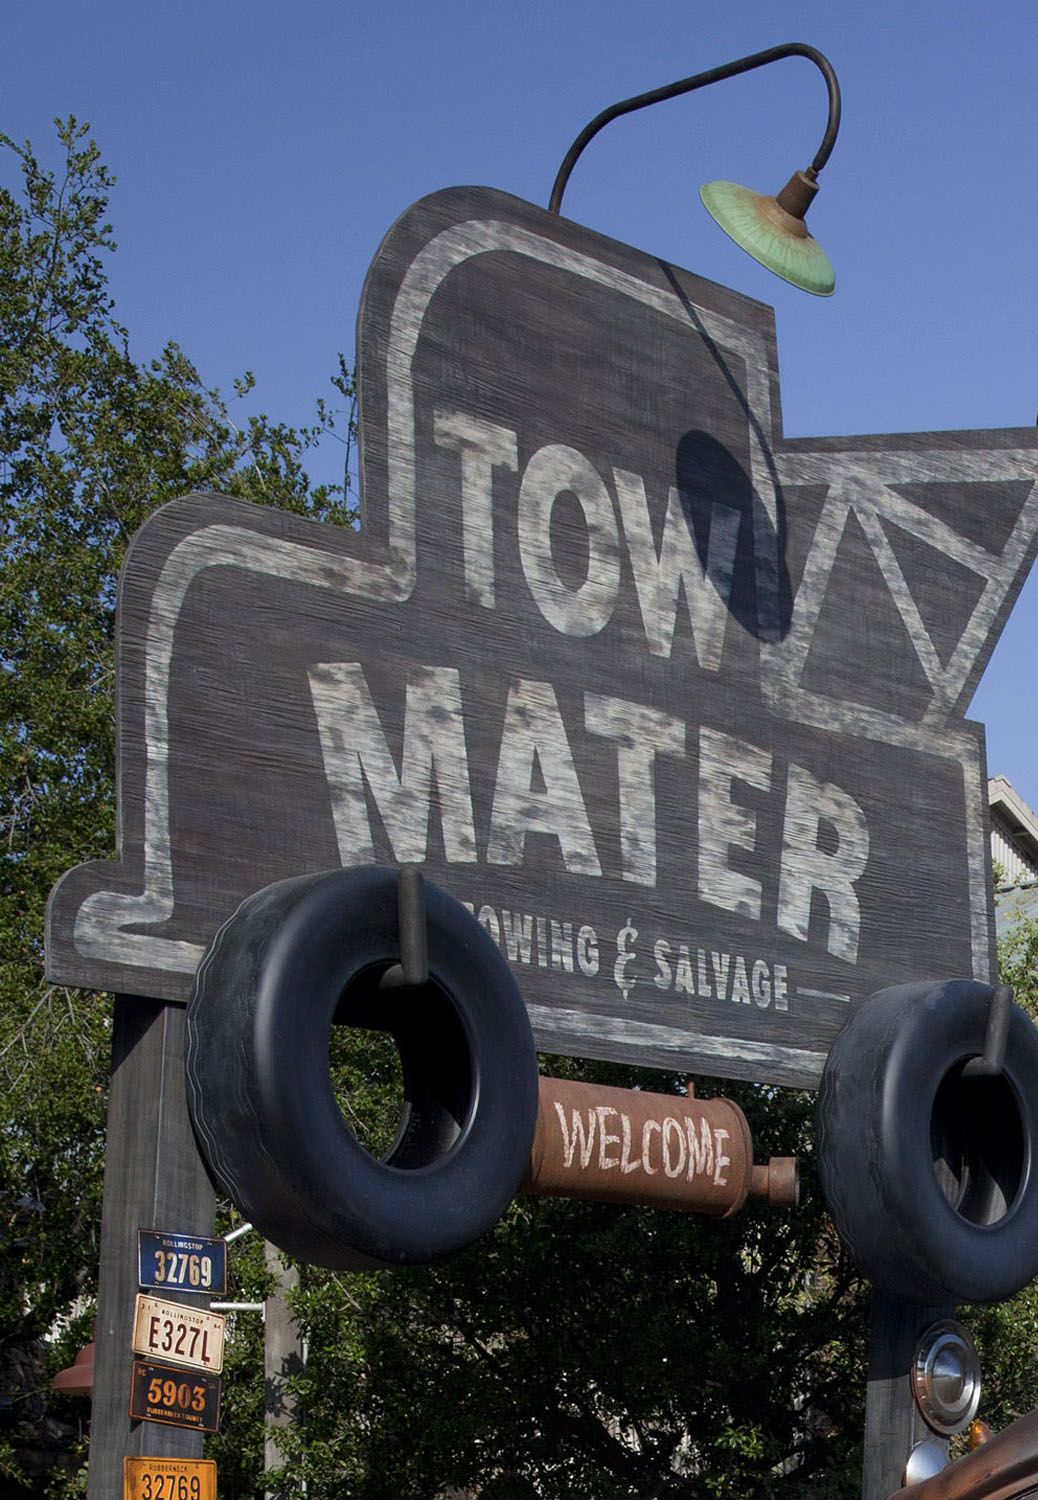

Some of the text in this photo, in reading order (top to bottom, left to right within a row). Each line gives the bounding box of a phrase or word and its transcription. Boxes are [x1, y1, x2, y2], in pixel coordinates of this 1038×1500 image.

[433, 408, 741, 673] TOW
[306, 661, 869, 965] MATER
[461, 901, 788, 1011] OWING & SALVAGE
[554, 1102, 730, 1186] WELCOME
[154, 1250, 212, 1287] 32769
[149, 1316, 210, 1362] E327L
[147, 1378, 206, 1411] 5903
